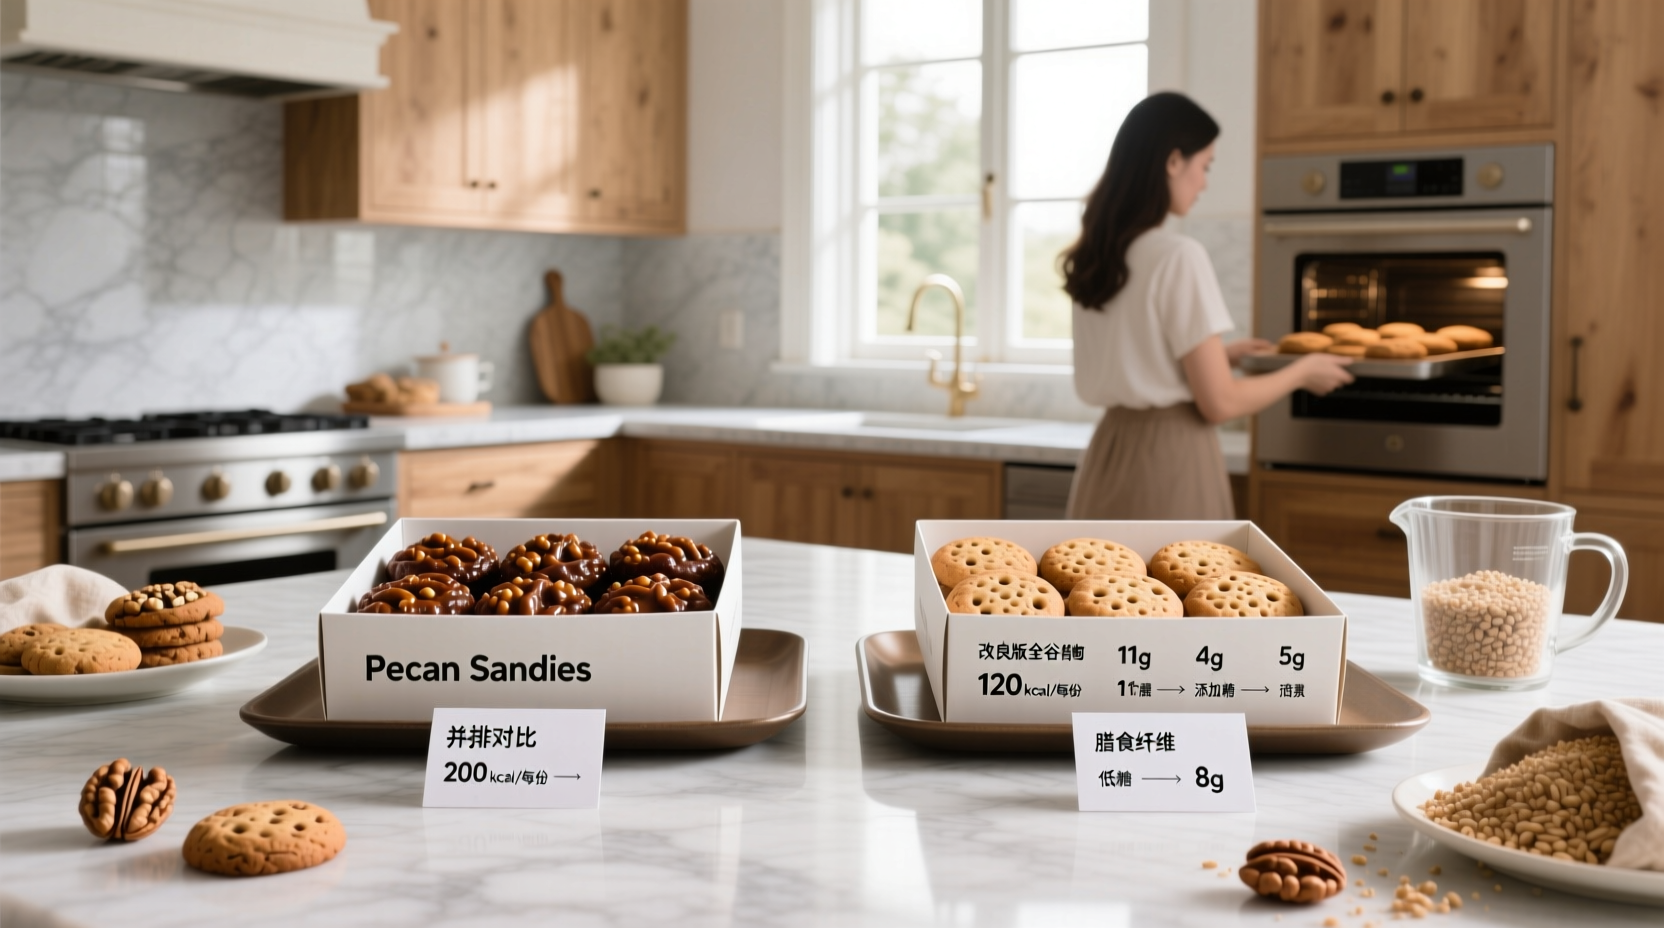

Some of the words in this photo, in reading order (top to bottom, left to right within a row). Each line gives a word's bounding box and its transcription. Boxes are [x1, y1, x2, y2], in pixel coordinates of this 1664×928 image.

[365, 654, 461, 683] Pecan
[469, 653, 592, 683] Sandies
[1117, 645, 1152, 671] 11g
[1195, 645, 1224, 672] 4g
[1278, 645, 1305, 672] 5g
[977, 672, 1023, 697] 120
[446, 724, 537, 750] 并排对比
[443, 761, 488, 783] 200
[1195, 765, 1224, 794] 8g
